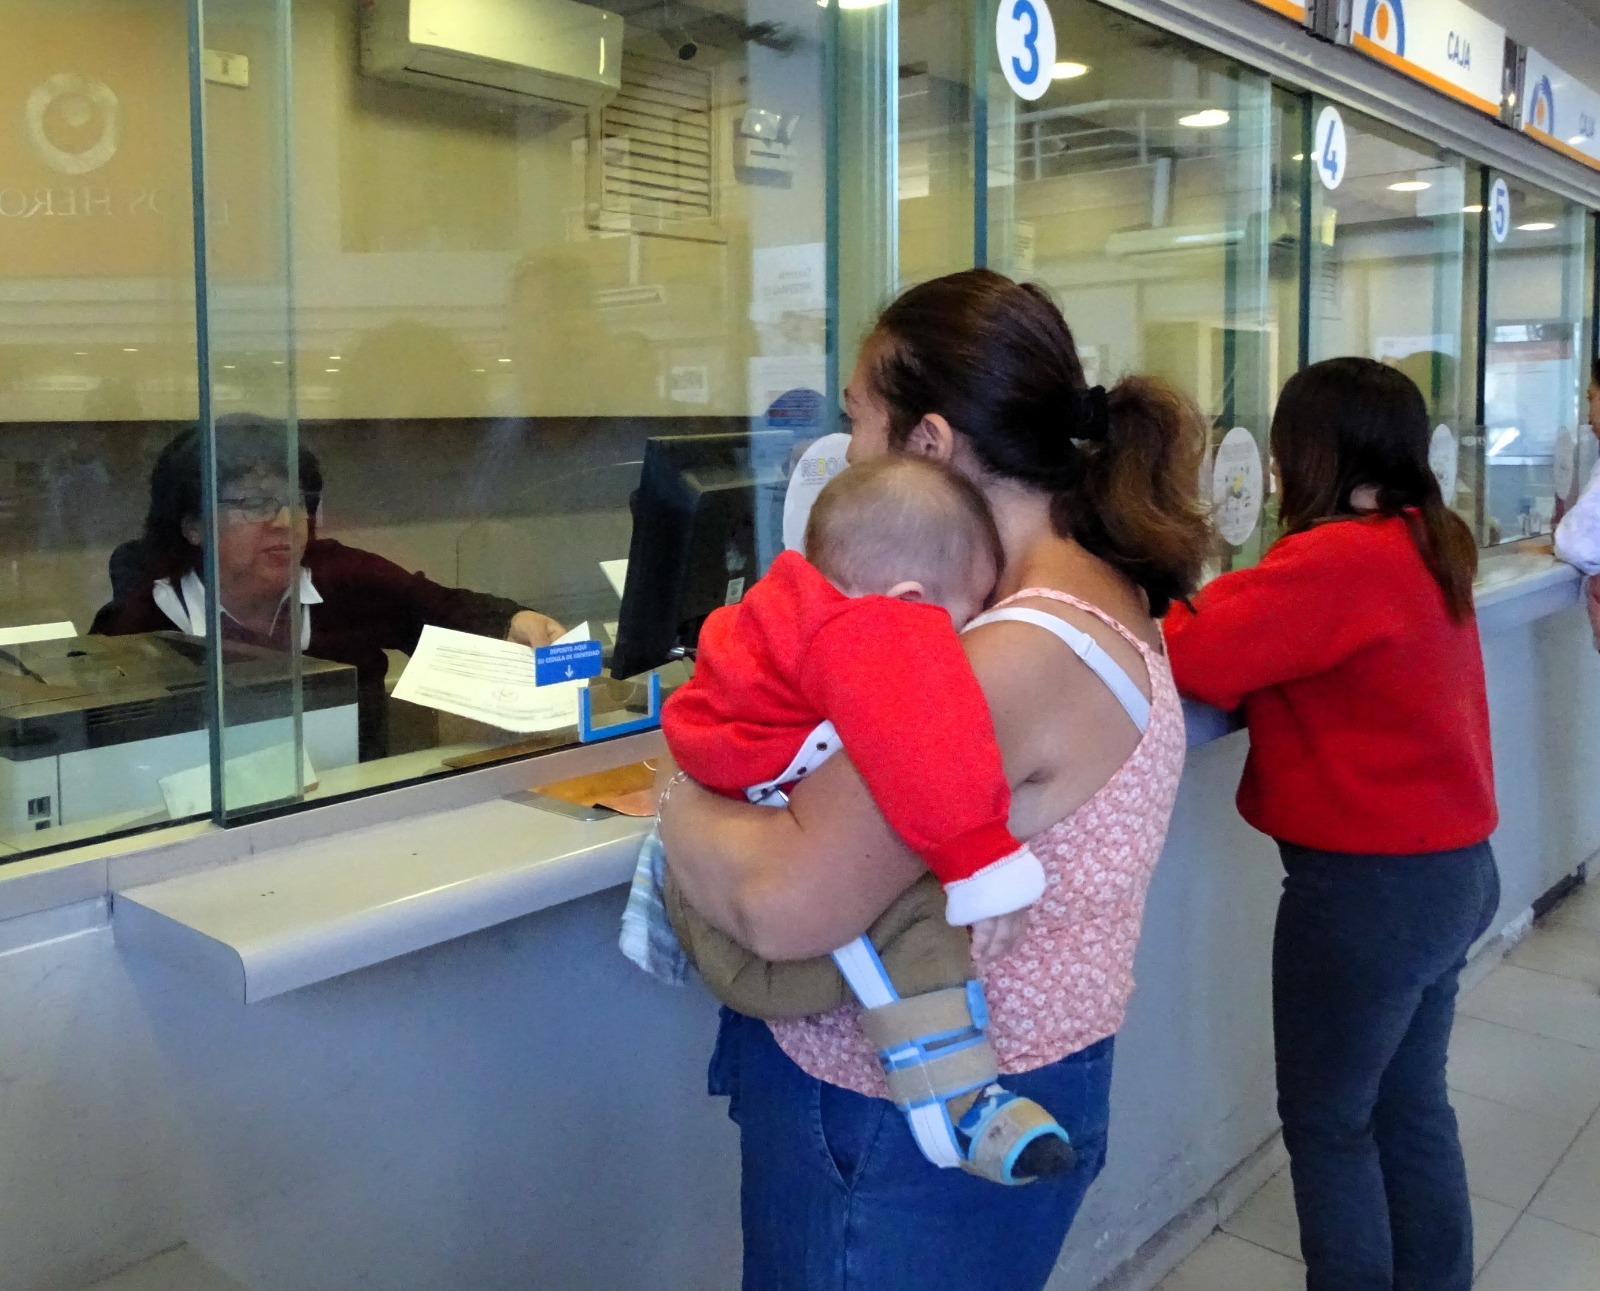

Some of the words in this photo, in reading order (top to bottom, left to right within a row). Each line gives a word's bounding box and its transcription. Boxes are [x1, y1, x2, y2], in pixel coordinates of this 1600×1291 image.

[1011, 0, 1039, 85] 3
[1448, 31, 1470, 71] CAJA
[1323, 120, 1337, 180] 4
[1494, 187, 1505, 235] 5
